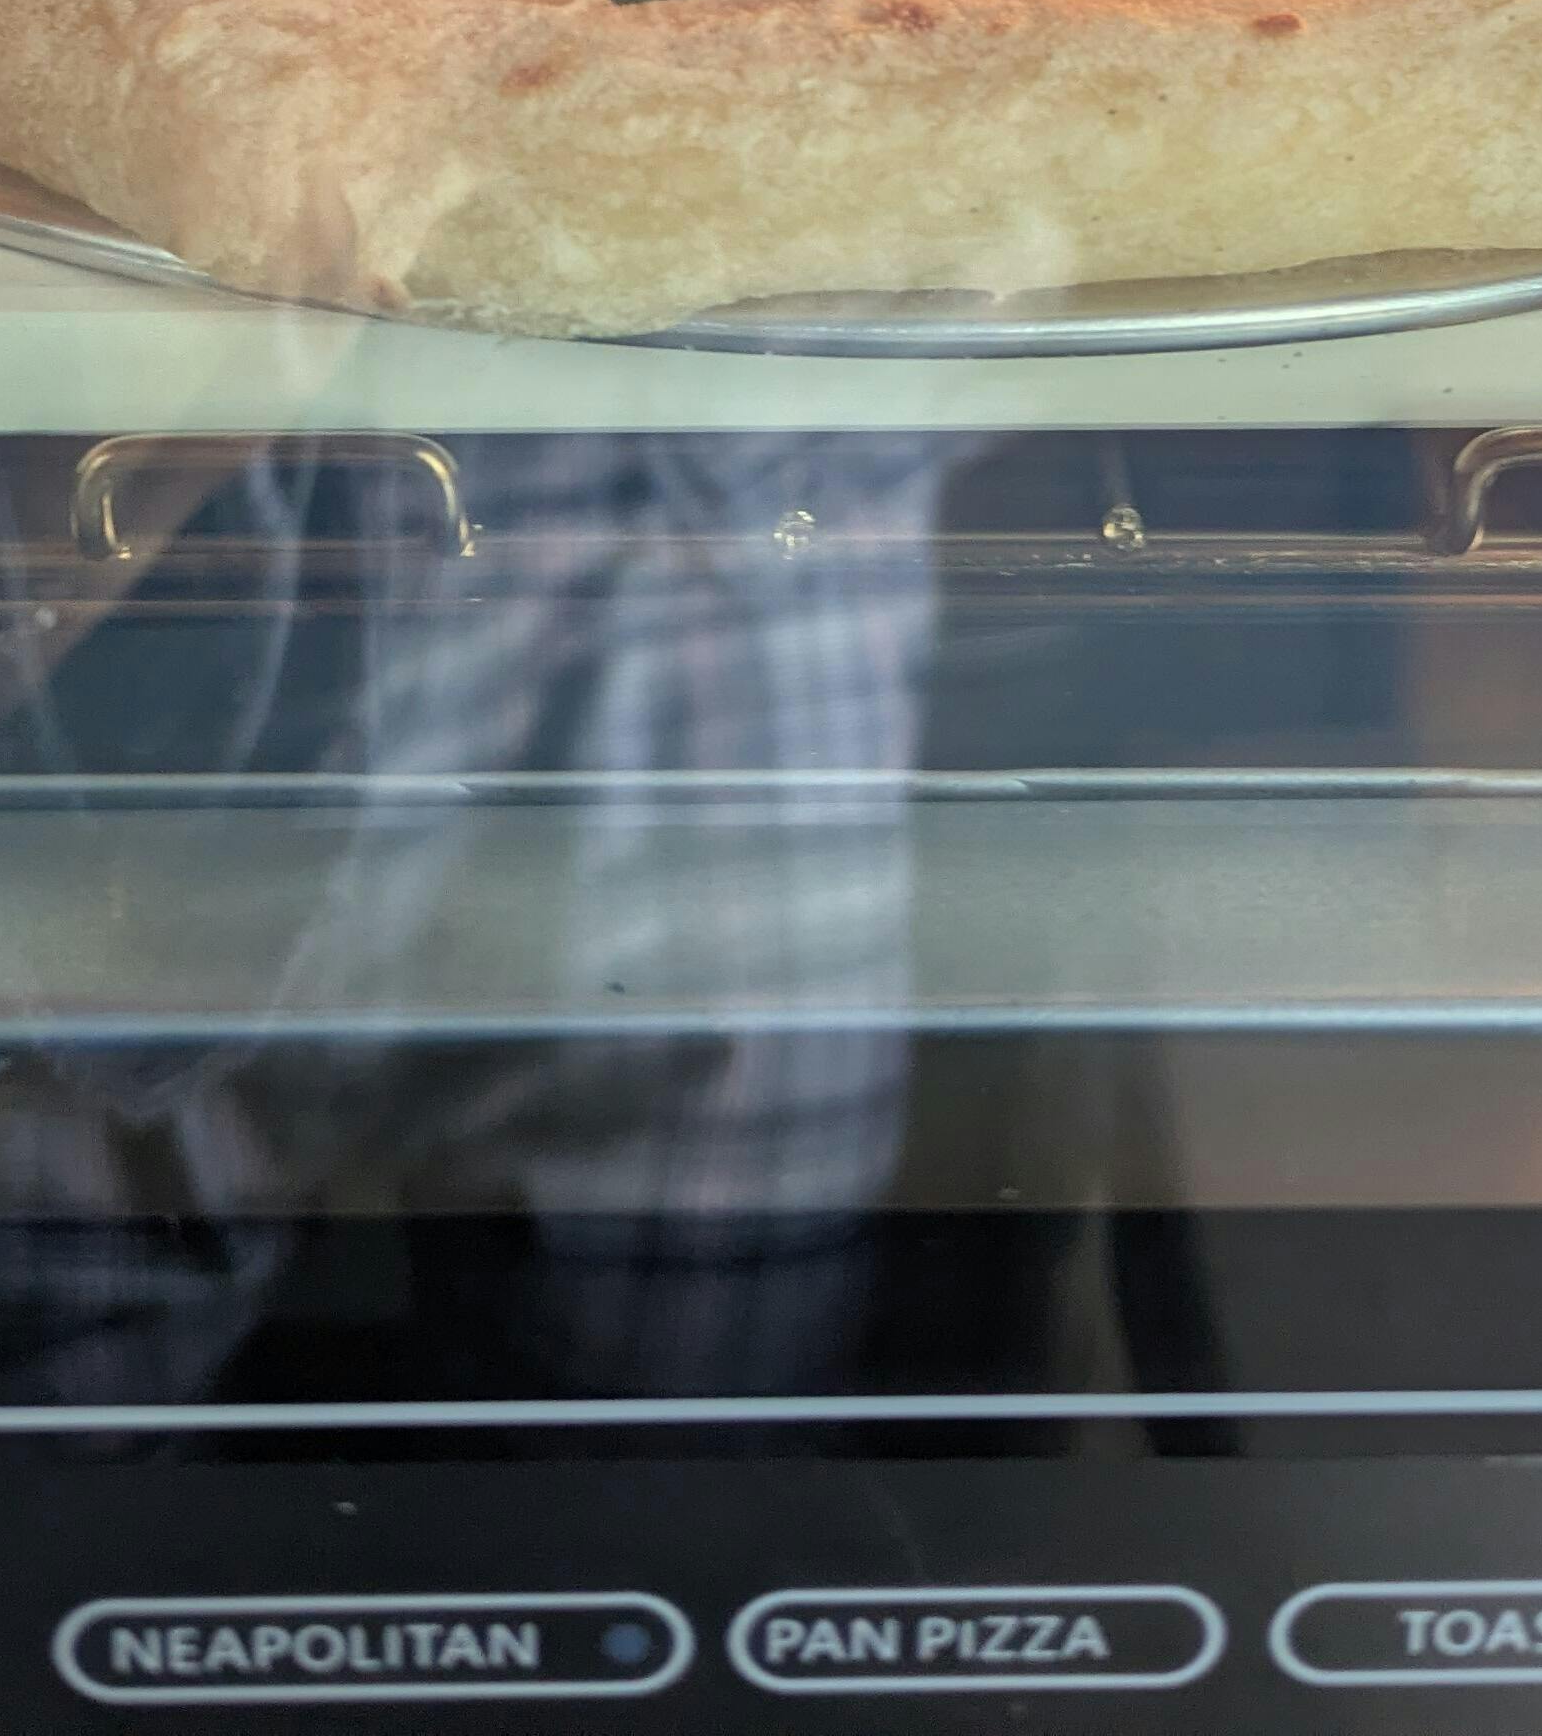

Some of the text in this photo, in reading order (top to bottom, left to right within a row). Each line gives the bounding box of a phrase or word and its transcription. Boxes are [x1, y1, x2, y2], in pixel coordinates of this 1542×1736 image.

[109, 1622, 540, 1673] NEAPOLITAN
[765, 1614, 1111, 1664] PAN PIZZA
